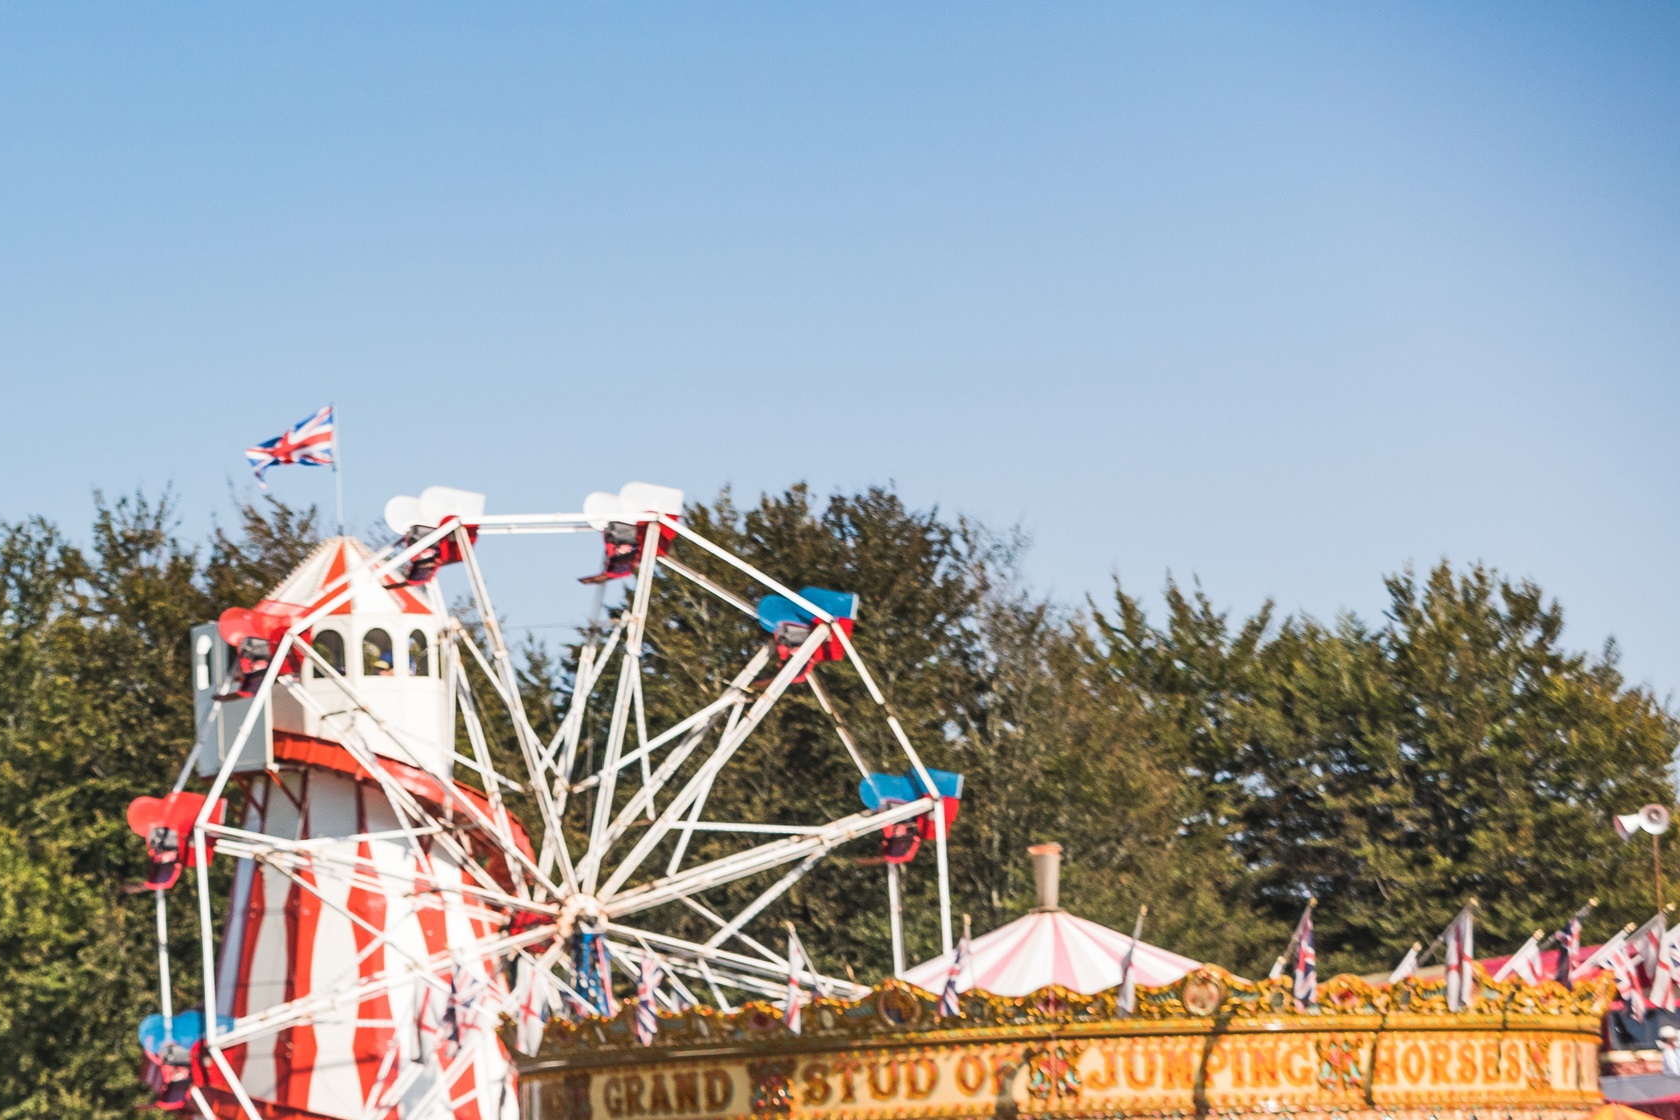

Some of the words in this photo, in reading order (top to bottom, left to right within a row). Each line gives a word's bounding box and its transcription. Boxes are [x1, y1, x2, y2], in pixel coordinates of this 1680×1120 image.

[603, 1068, 734, 1119] GRAND
[801, 1055, 940, 1107] STUD
[954, 1052, 1020, 1098] OF
[1085, 1043, 1314, 1092] JUMPING
[1374, 1043, 1522, 1085] HORSES
